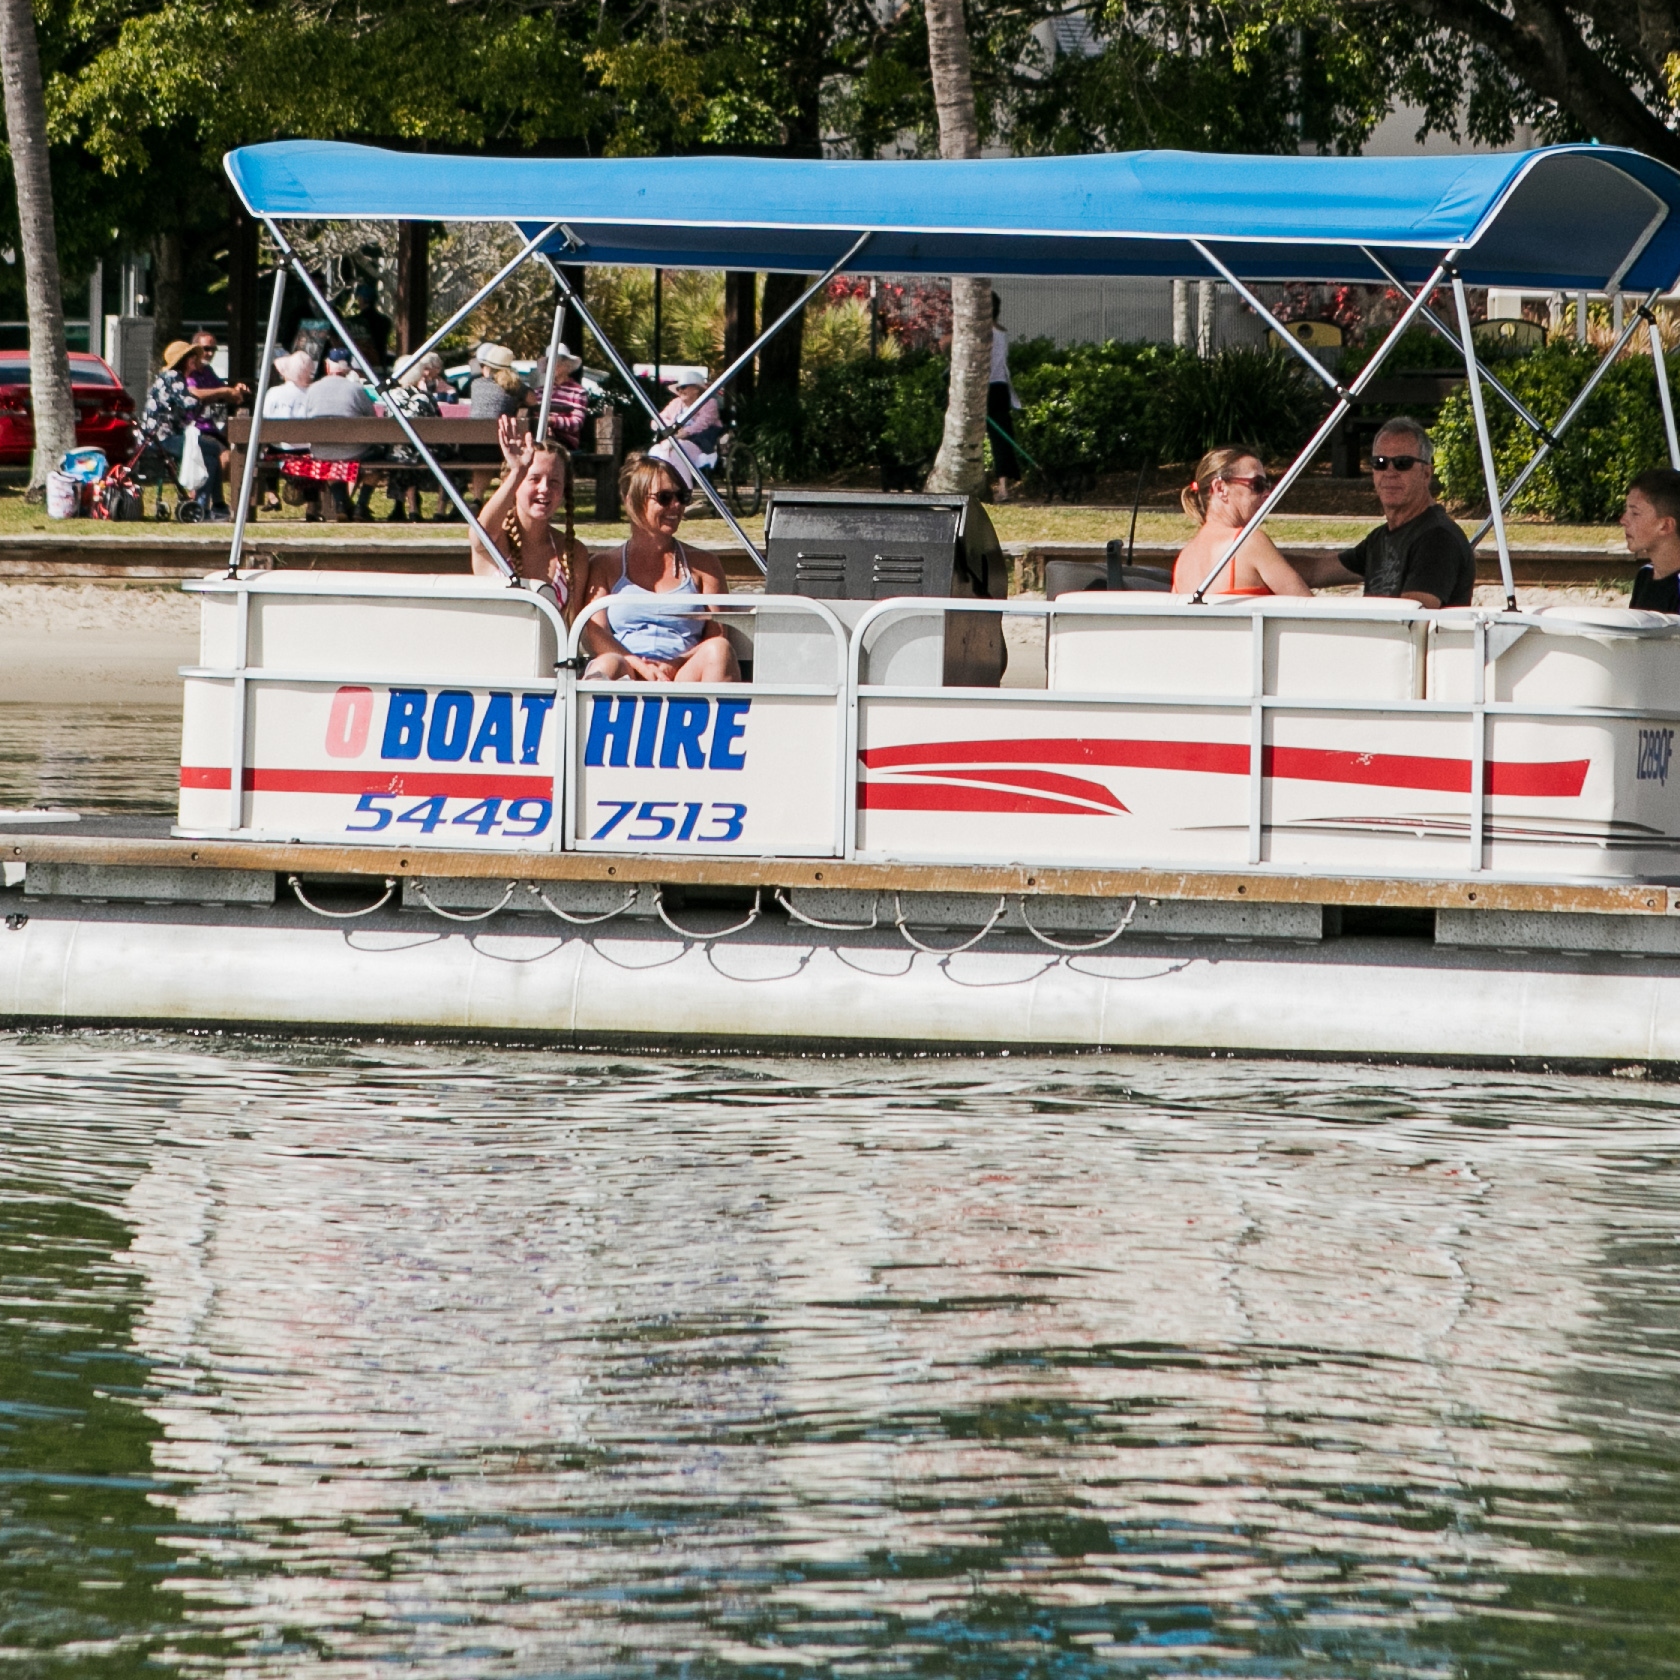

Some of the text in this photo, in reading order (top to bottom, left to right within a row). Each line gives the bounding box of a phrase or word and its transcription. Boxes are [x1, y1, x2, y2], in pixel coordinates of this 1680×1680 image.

[381, 687, 557, 765] BOAT
[585, 695, 752, 770] HIRE
[1636, 728, 1675, 786] 1289QF
[346, 792, 749, 842] 5449 7513
